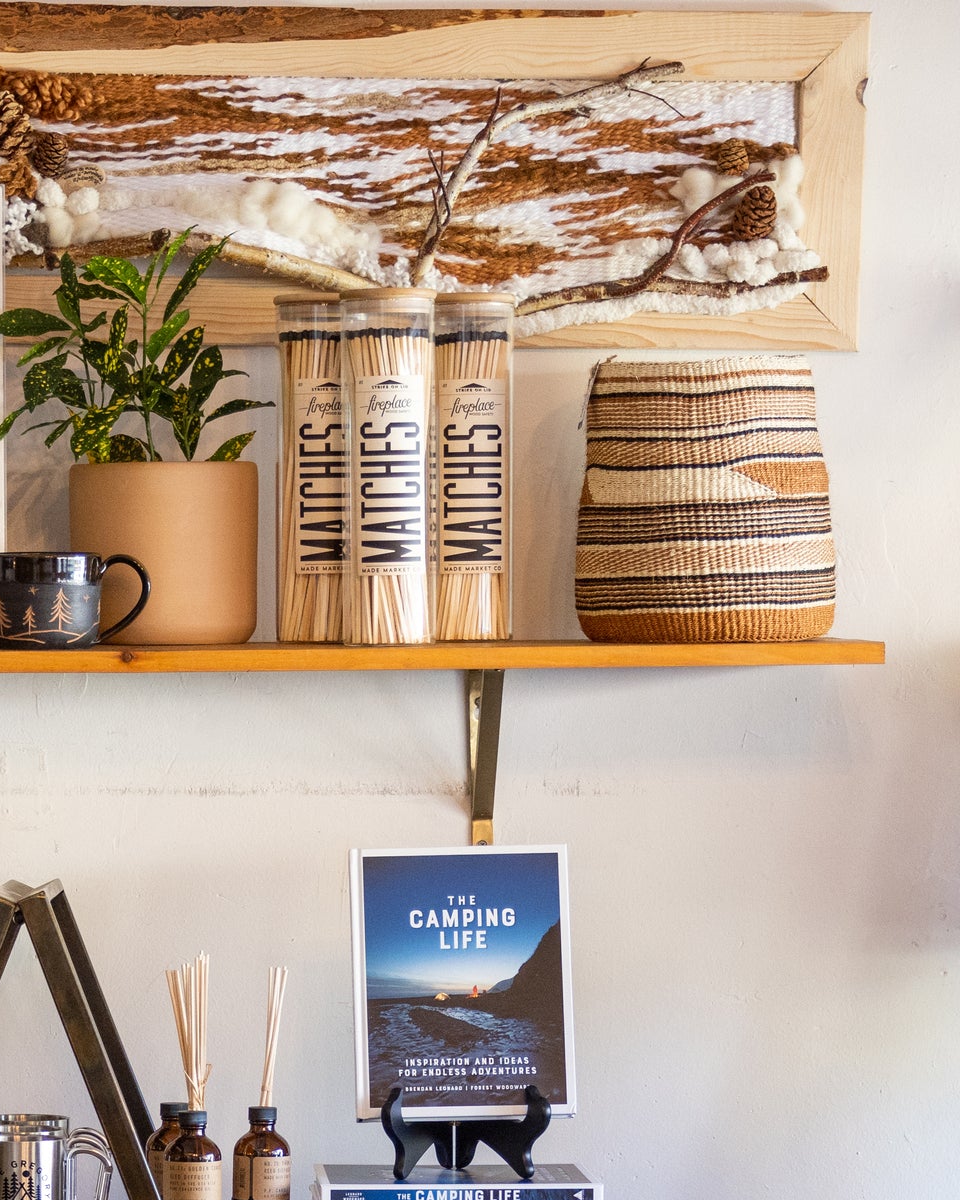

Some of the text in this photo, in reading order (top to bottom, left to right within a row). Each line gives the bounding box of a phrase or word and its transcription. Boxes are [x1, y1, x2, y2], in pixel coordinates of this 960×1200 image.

[306, 397, 342, 419] firepla
[367, 394, 412, 417] fireplace
[450, 397, 495, 419] fireplace
[360, 422, 421, 563] MATCHES
[443, 424, 502, 562] MATCHES
[448, 896, 476, 906] THE
[409, 908, 516, 928] CAMPING
[439, 930, 487, 950] LIFE
[399, 1067, 537, 1077] FOR ENDLESS ADVENTURES
[405, 1058, 470, 1067] INSPIRATION
[396, 1193, 412, 1200] THE
